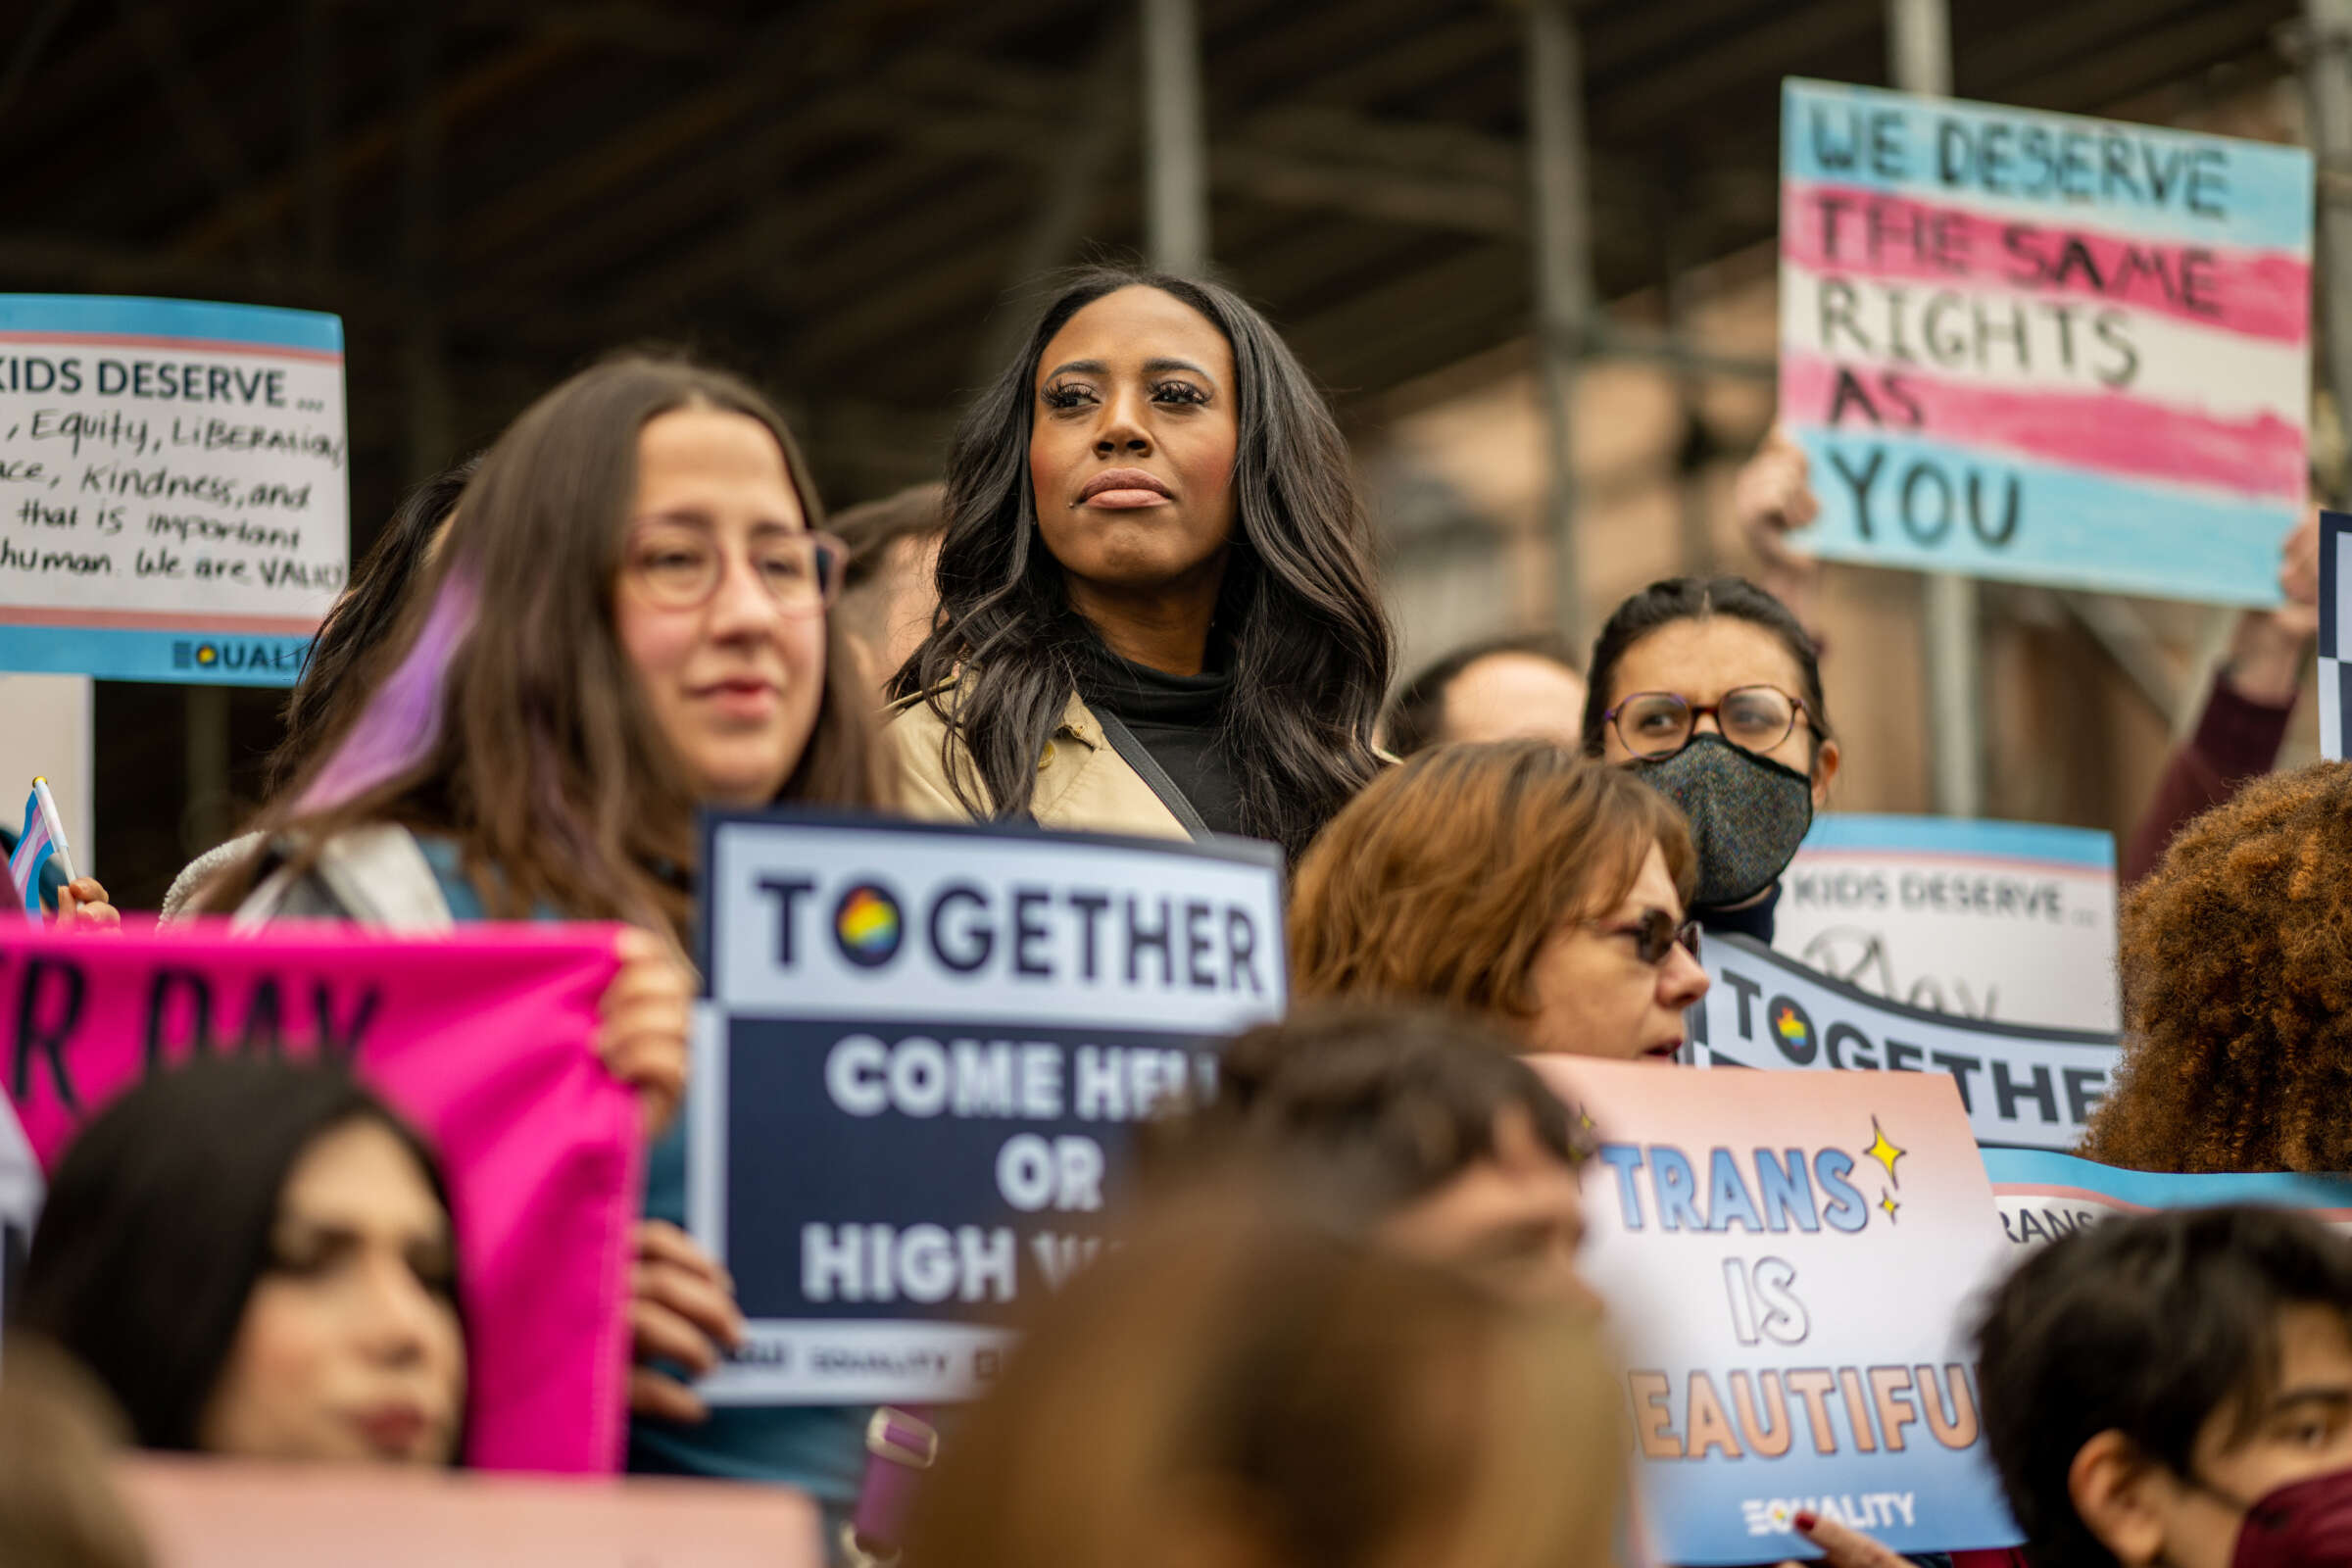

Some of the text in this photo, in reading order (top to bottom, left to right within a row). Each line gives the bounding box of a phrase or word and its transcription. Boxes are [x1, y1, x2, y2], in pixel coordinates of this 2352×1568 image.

[1811, 105, 2230, 221] WE DESERVE
[1811, 186, 2223, 318] THE SAME
[1818, 278, 2139, 387] RIGHTS
[1829, 365, 1925, 428] AS
[18, 498, 300, 550] that is important
[250, 483, 311, 510] and
[1828, 444, 2021, 549] YOU
[136, 545, 185, 578] We
[196, 557, 251, 585] are
[172, 641, 303, 670] EQUALI
[752, 869, 1265, 996] TOGETHER
[1794, 870, 1887, 911] KIDS
[824, 1034, 1064, 1119] COME
[1721, 967, 2107, 1123] TOGETHE
[995, 1133, 1104, 1213] OR
[1599, 1143, 1869, 1234] TRANS
[801, 1222, 1016, 1304] HIGH
[1722, 1256, 1809, 1347] IS
[1628, 1363, 1981, 1460] EAUTIFU
